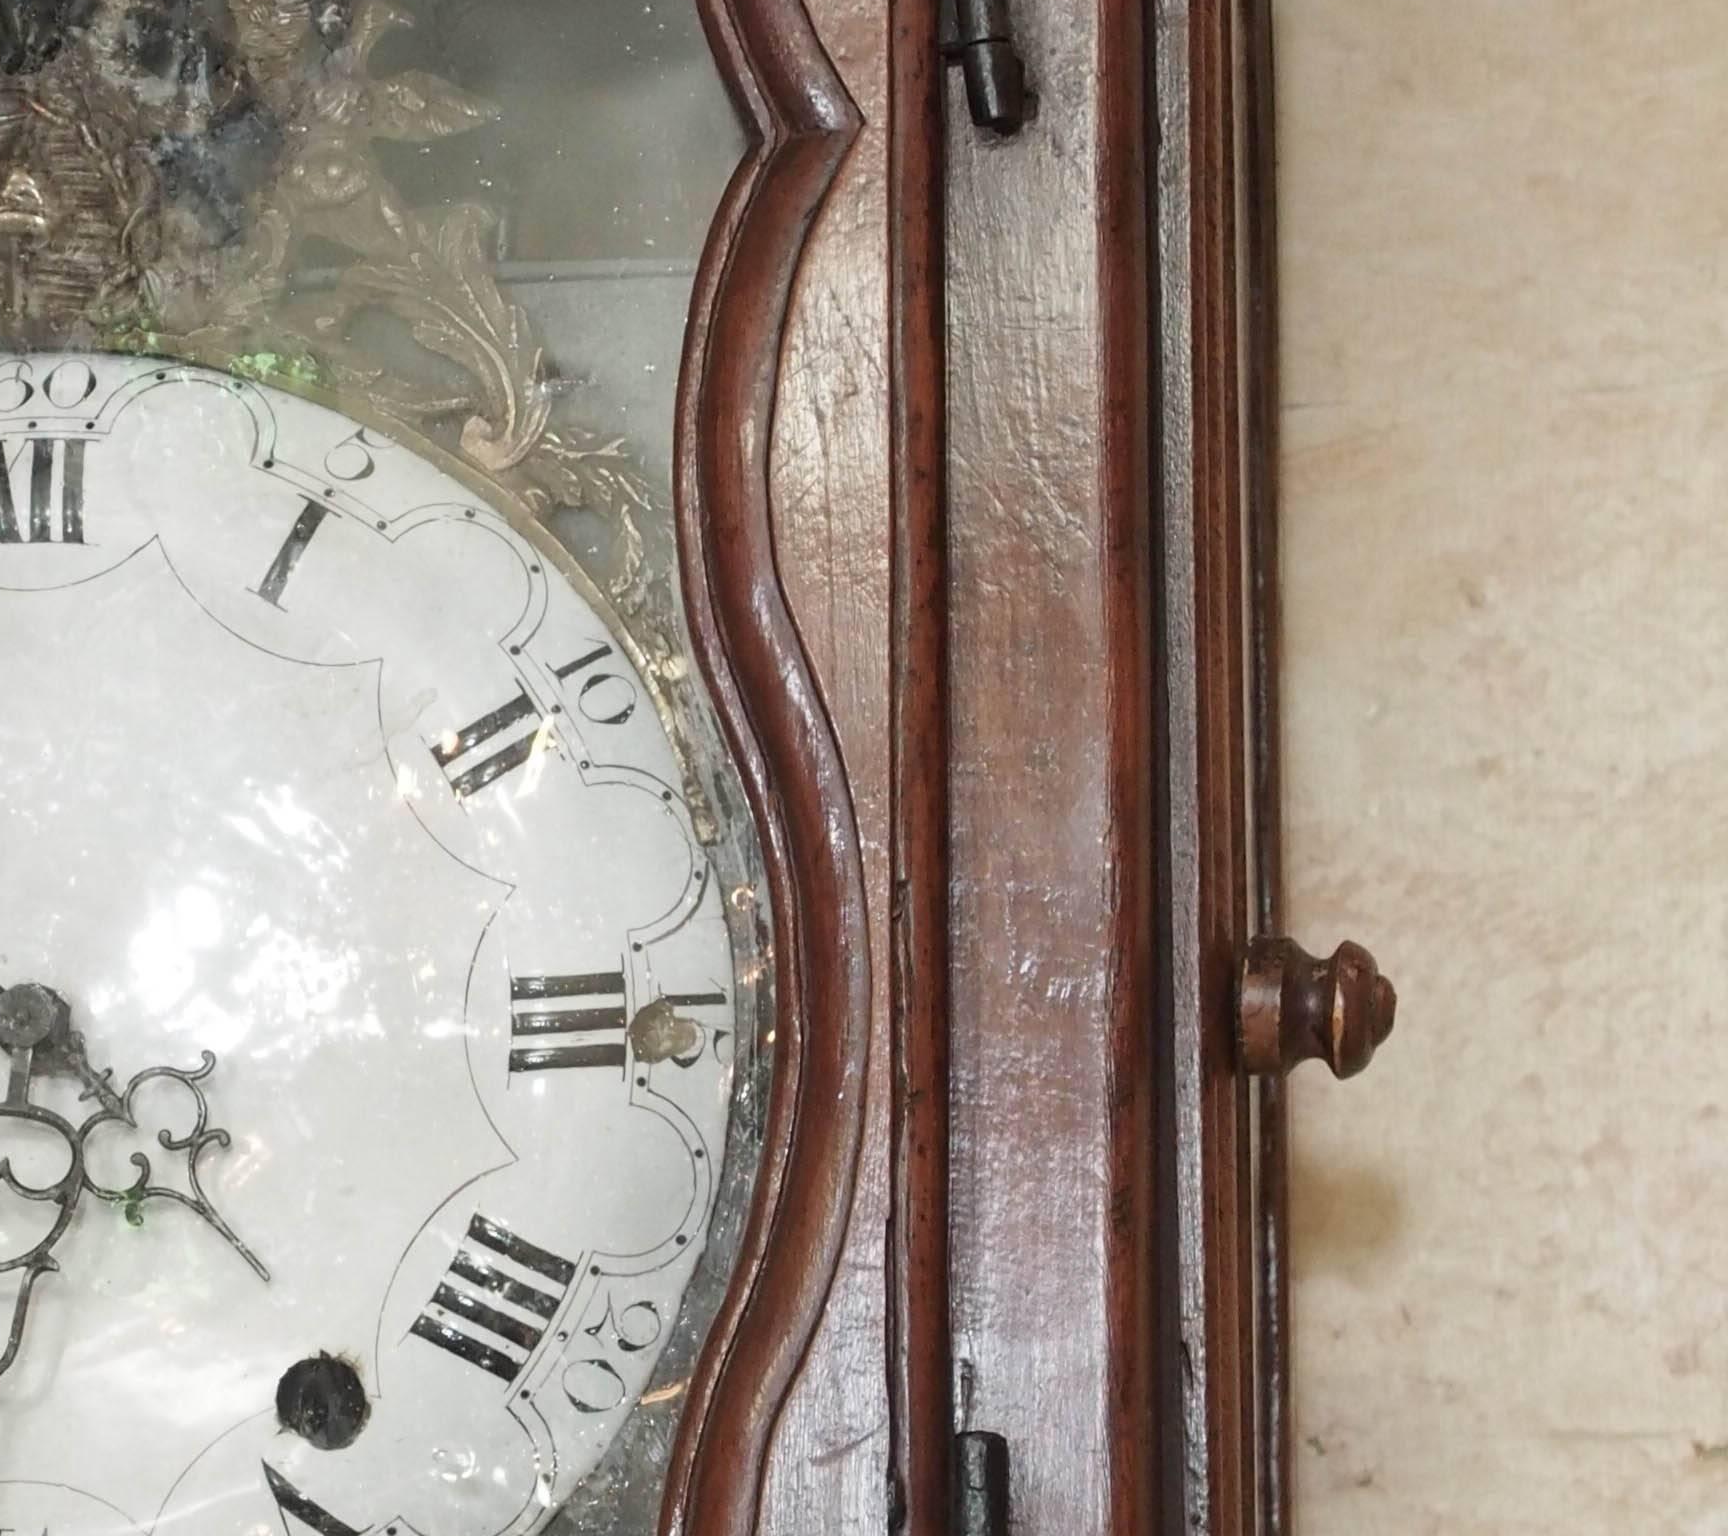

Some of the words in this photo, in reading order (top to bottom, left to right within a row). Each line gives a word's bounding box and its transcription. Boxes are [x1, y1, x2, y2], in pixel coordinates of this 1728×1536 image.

[324, 426, 397, 481] 5
[245, 492, 342, 613] I
[545, 637, 638, 725] 10
[421, 676, 565, 816] II
[507, 951, 627, 1091] III
[397, 1200, 584, 1394] IIII
[562, 1289, 662, 1413] 20
